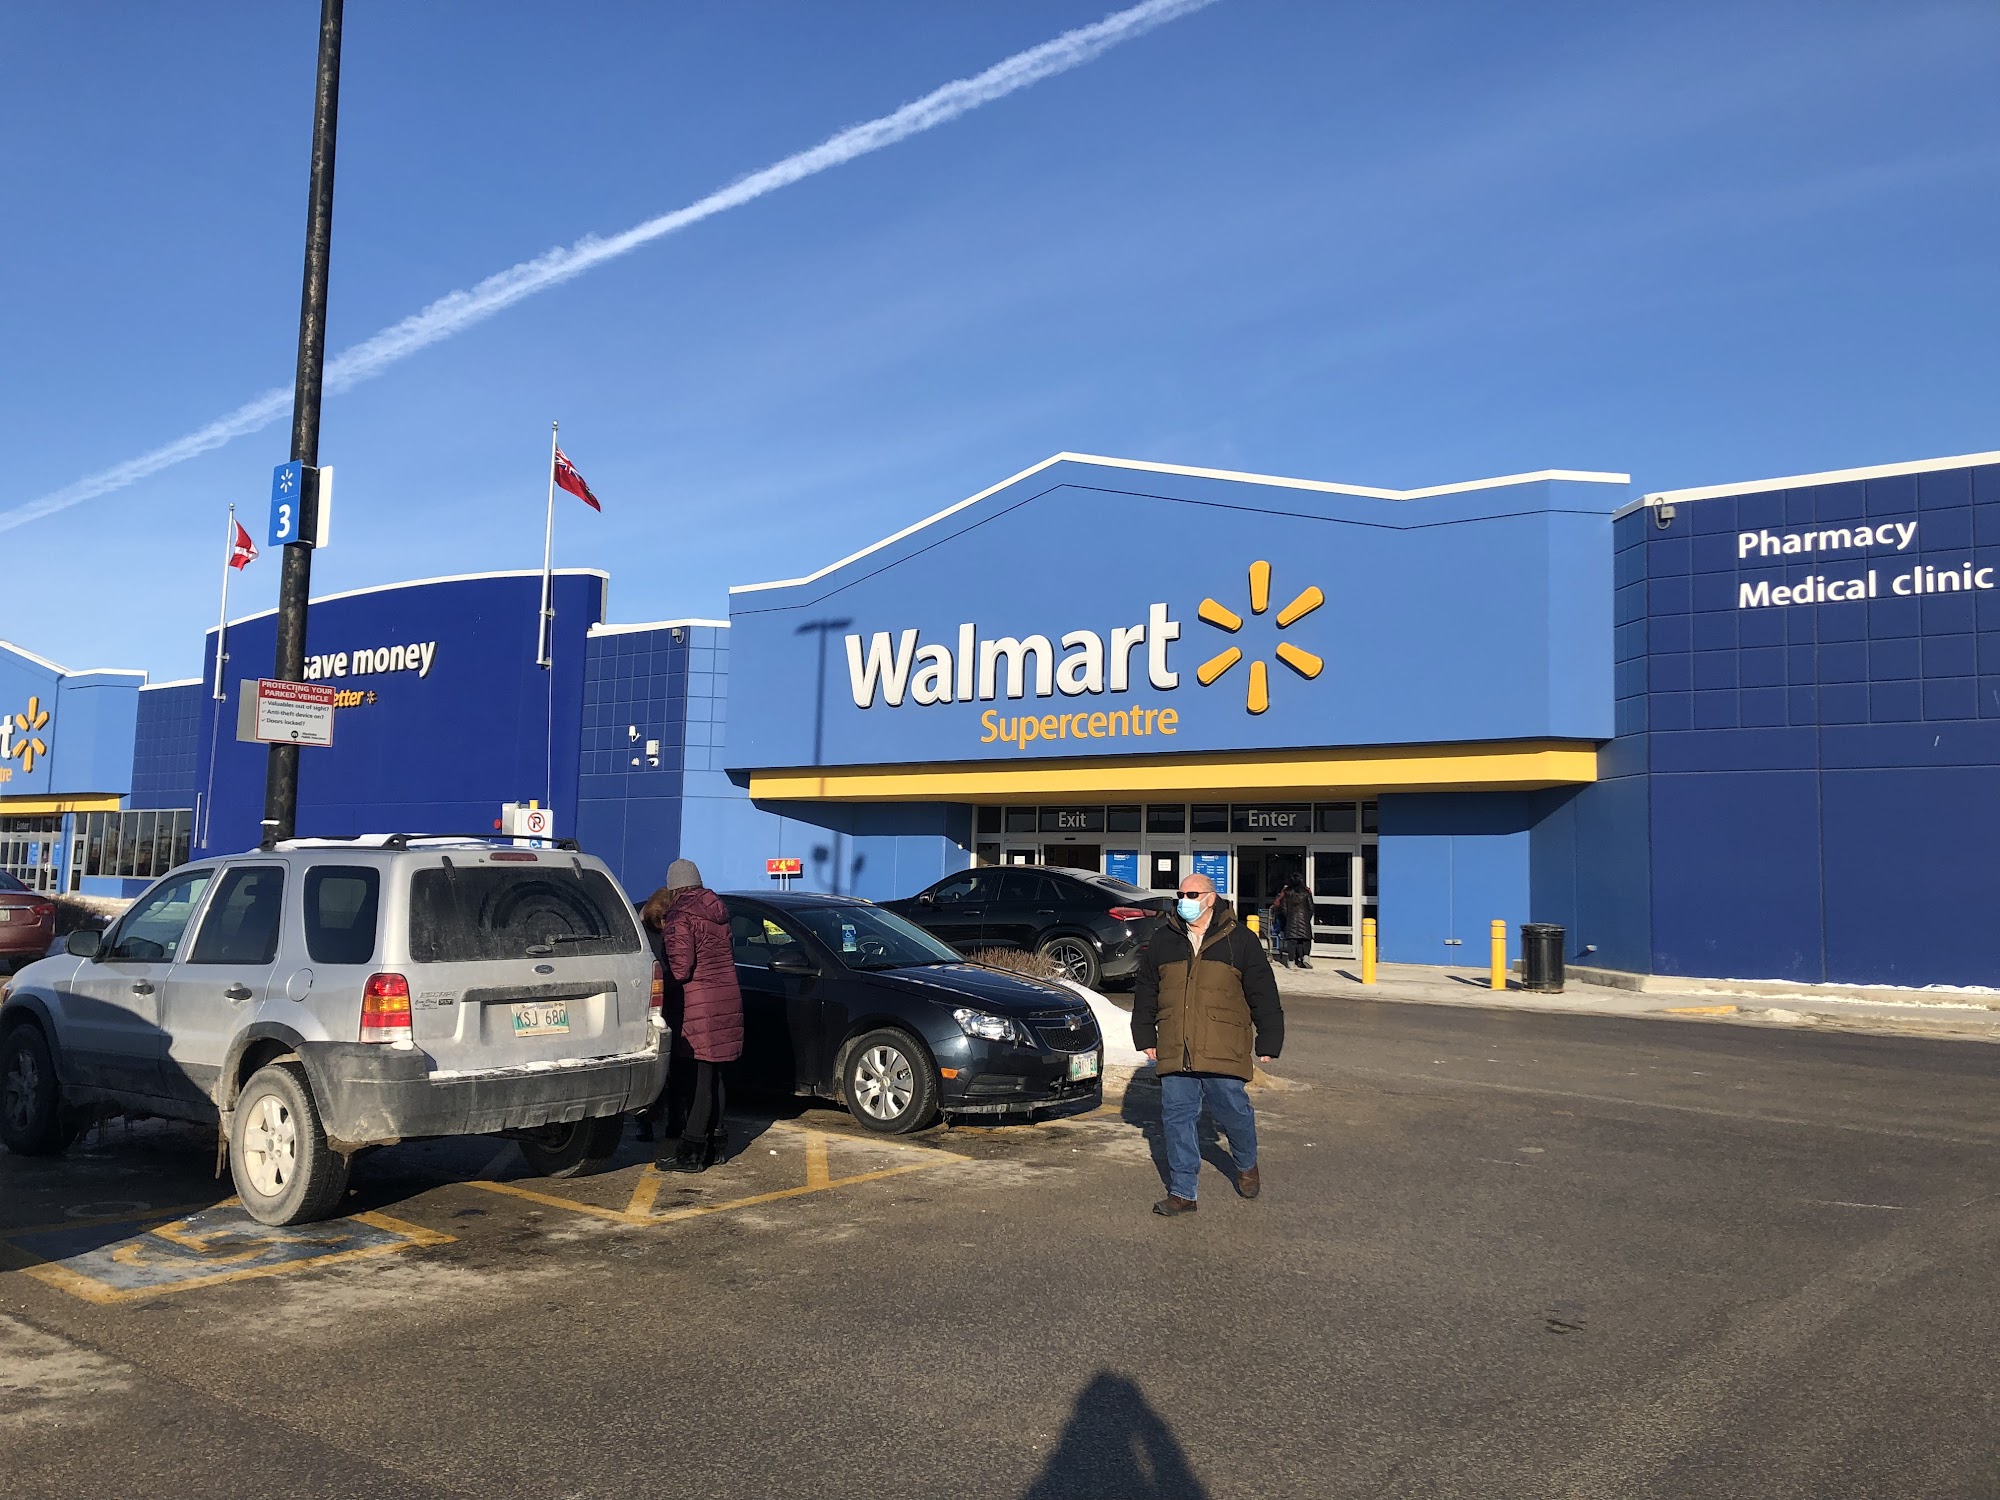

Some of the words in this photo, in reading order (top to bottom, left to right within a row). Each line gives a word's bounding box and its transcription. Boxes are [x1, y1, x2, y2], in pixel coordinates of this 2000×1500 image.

[276, 503, 291, 538] 3
[1738, 521, 1917, 559] Pharmacy
[1738, 569, 1876, 609] Medical
[1892, 561, 1994, 596] clinic
[352, 640, 436, 678] money
[844, 602, 1180, 708] Walmart
[261, 680, 310, 692] PROTECTING
[311, 686, 333, 695] YOUR
[264, 689, 296, 699] PARKED
[298, 693, 329, 702] VEHICLE
[334, 689, 365, 707] etter
[980, 704, 1178, 749] Supercentre
[1058, 811, 1087, 828] Exit
[1248, 809, 1297, 828] Enter
[515, 1010, 539, 1028] KSJ
[545, 1009, 567, 1026] 680
